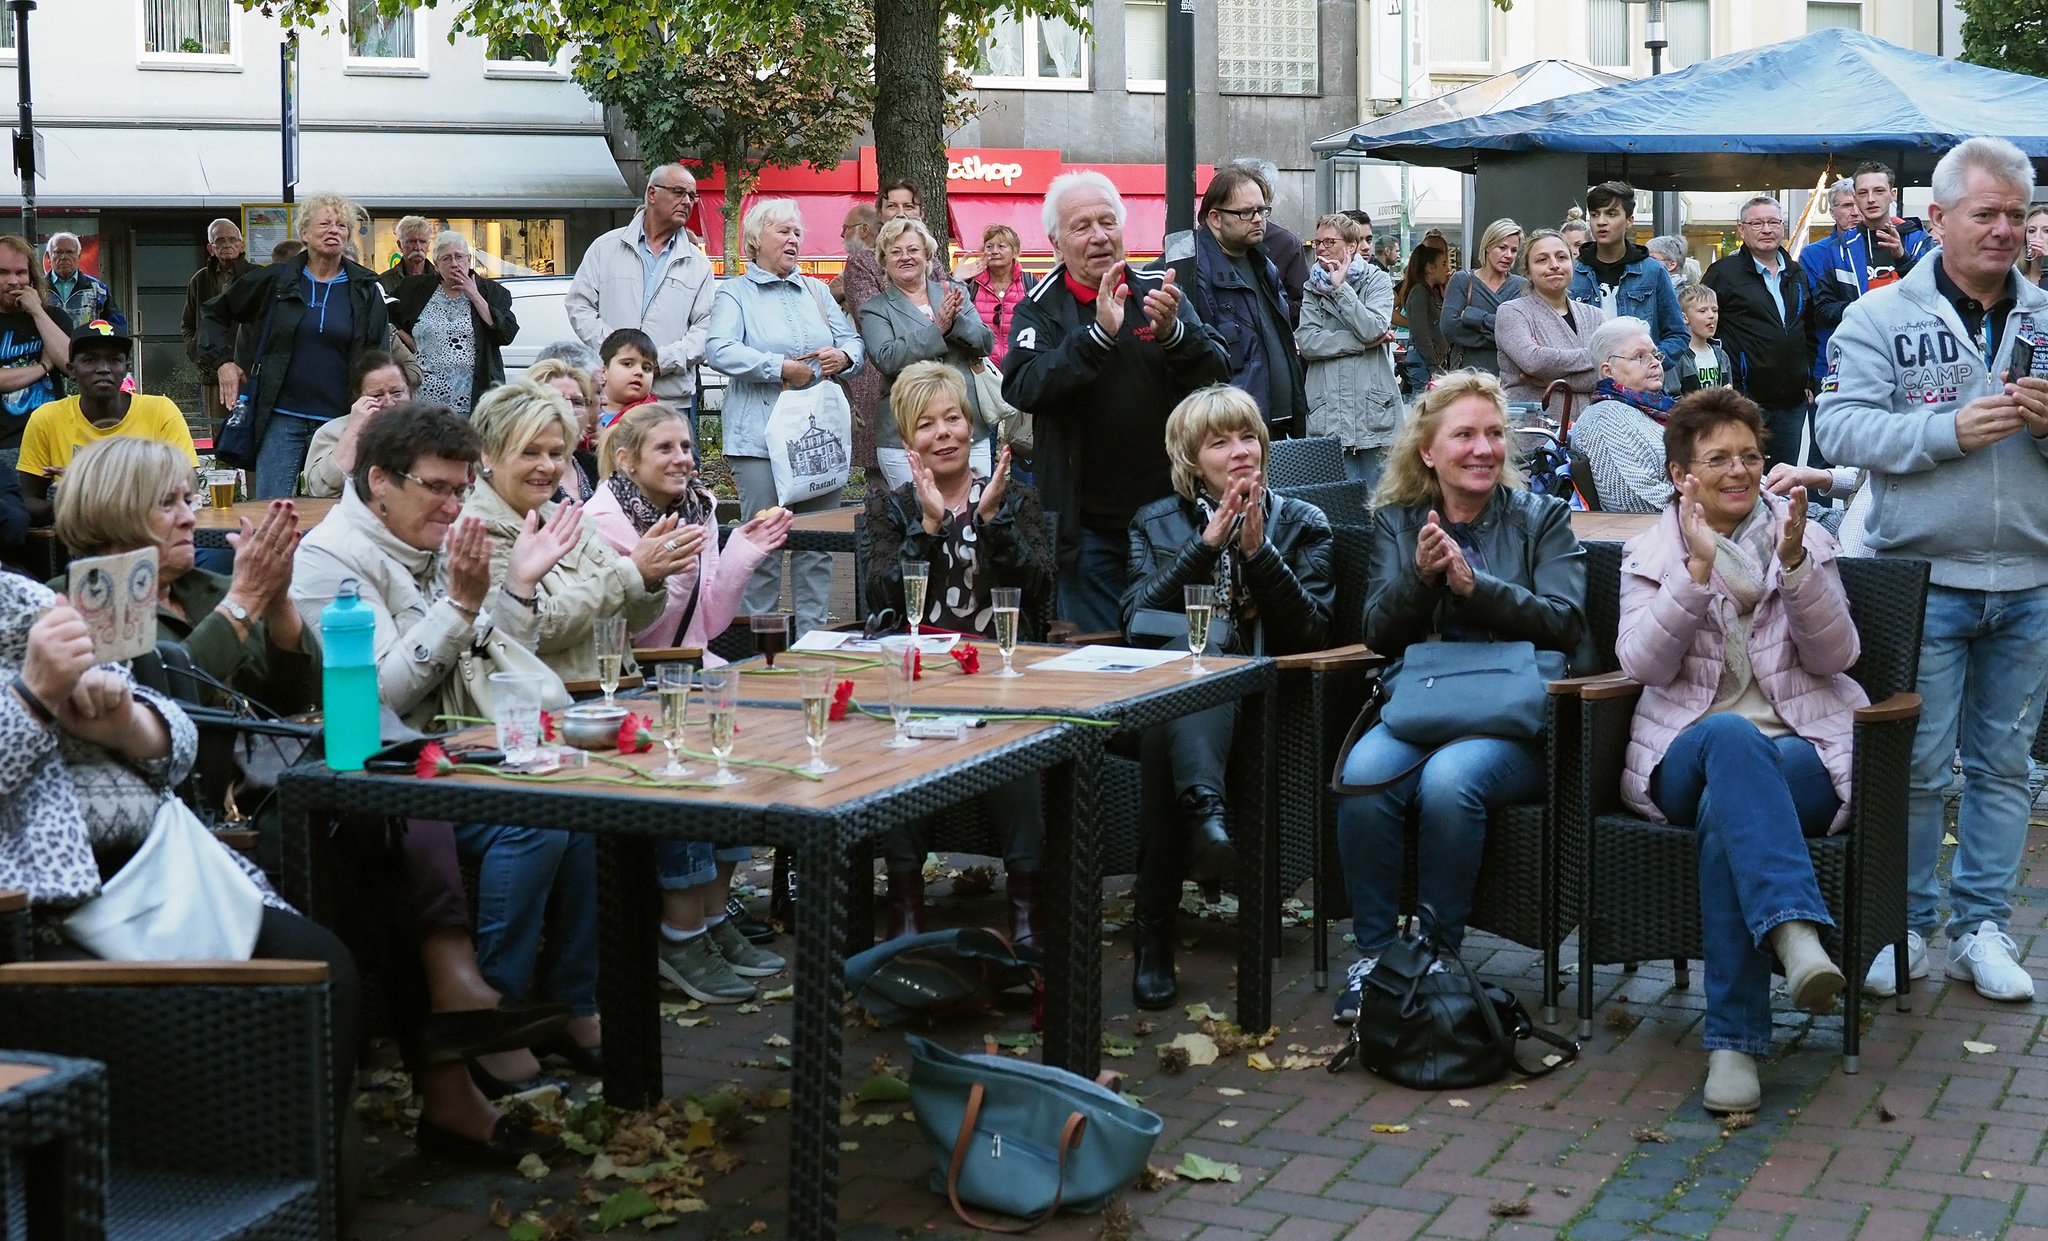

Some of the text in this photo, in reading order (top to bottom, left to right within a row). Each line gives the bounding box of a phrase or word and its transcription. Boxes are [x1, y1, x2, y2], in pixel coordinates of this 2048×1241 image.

[1894, 331, 1959, 368] CAD
[1901, 364, 1973, 390] CAMP
[808, 477, 837, 492] Rastatt
